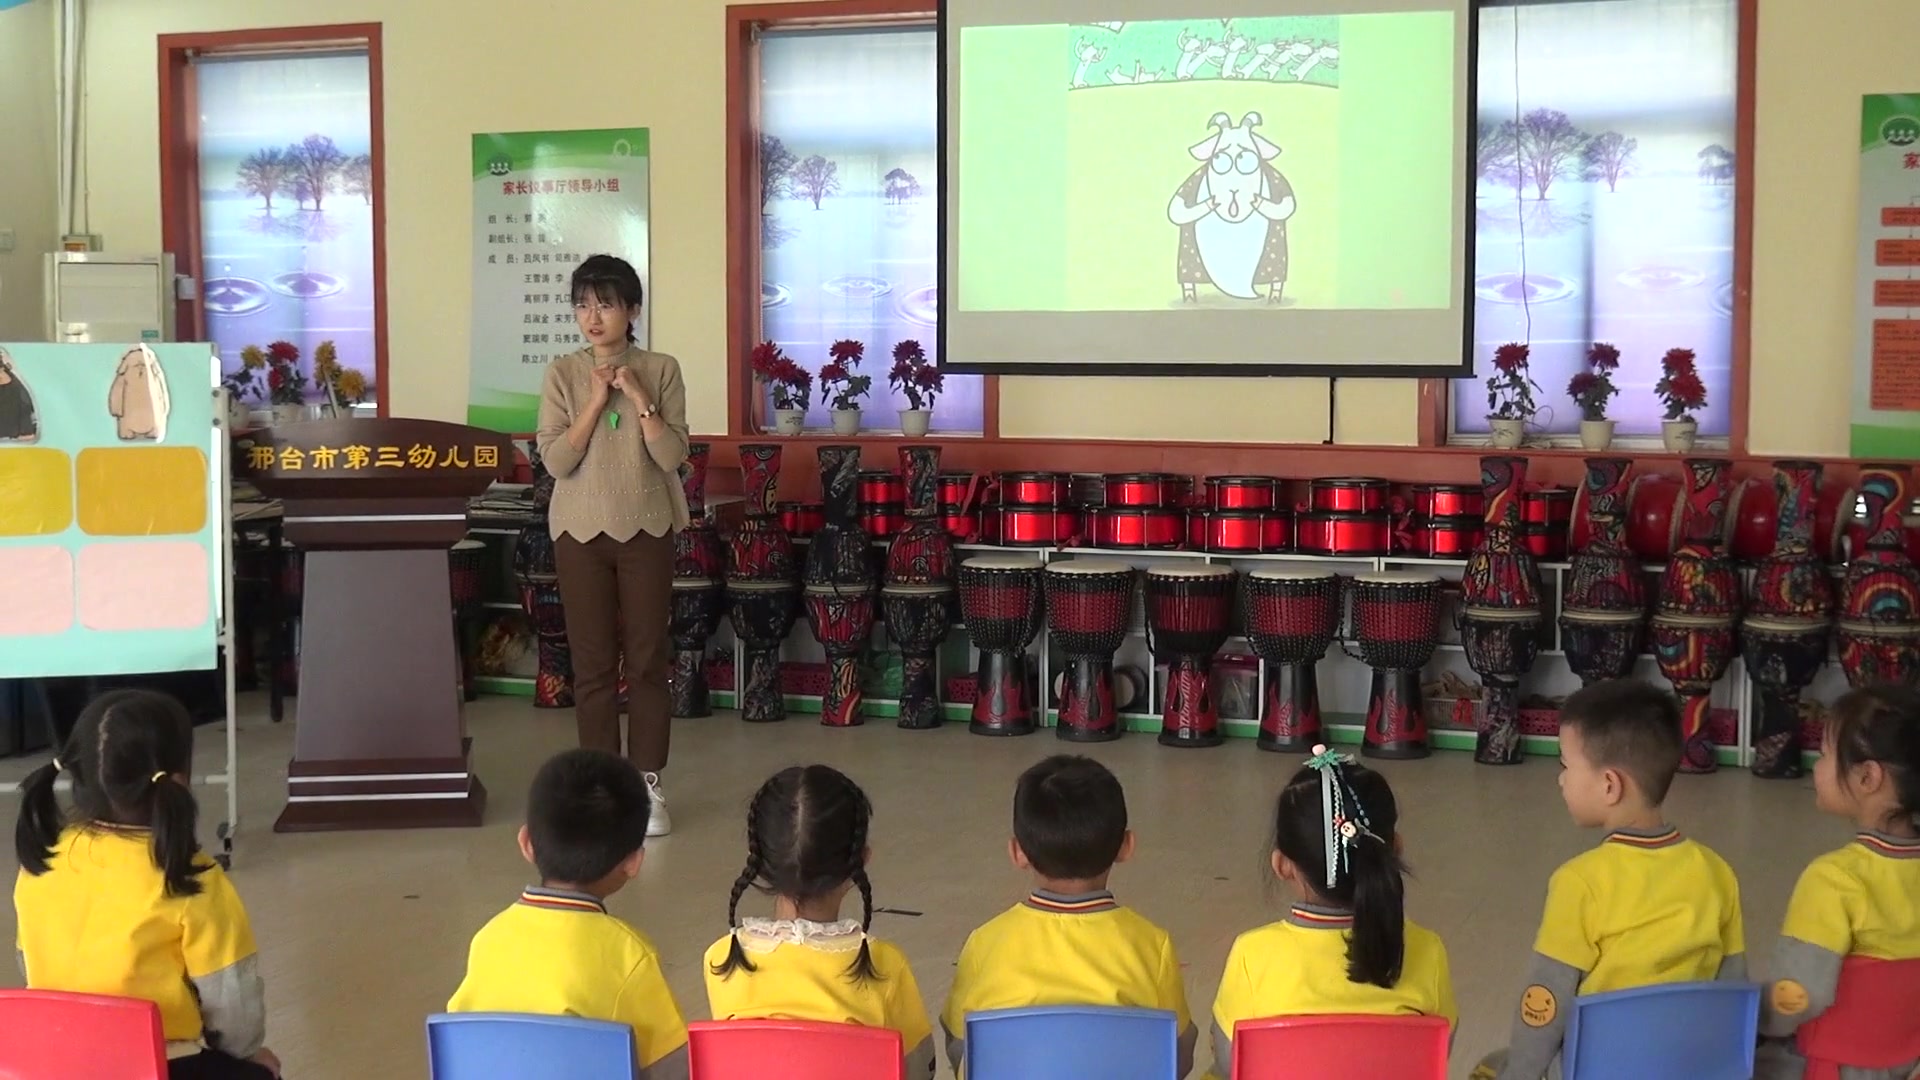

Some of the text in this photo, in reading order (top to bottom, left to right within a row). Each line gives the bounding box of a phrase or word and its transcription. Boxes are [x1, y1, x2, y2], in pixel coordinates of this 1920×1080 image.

[503, 178, 620, 195] 家长议事厅领导小组
[247, 444, 499, 470] 邢台市第三幼儿园
